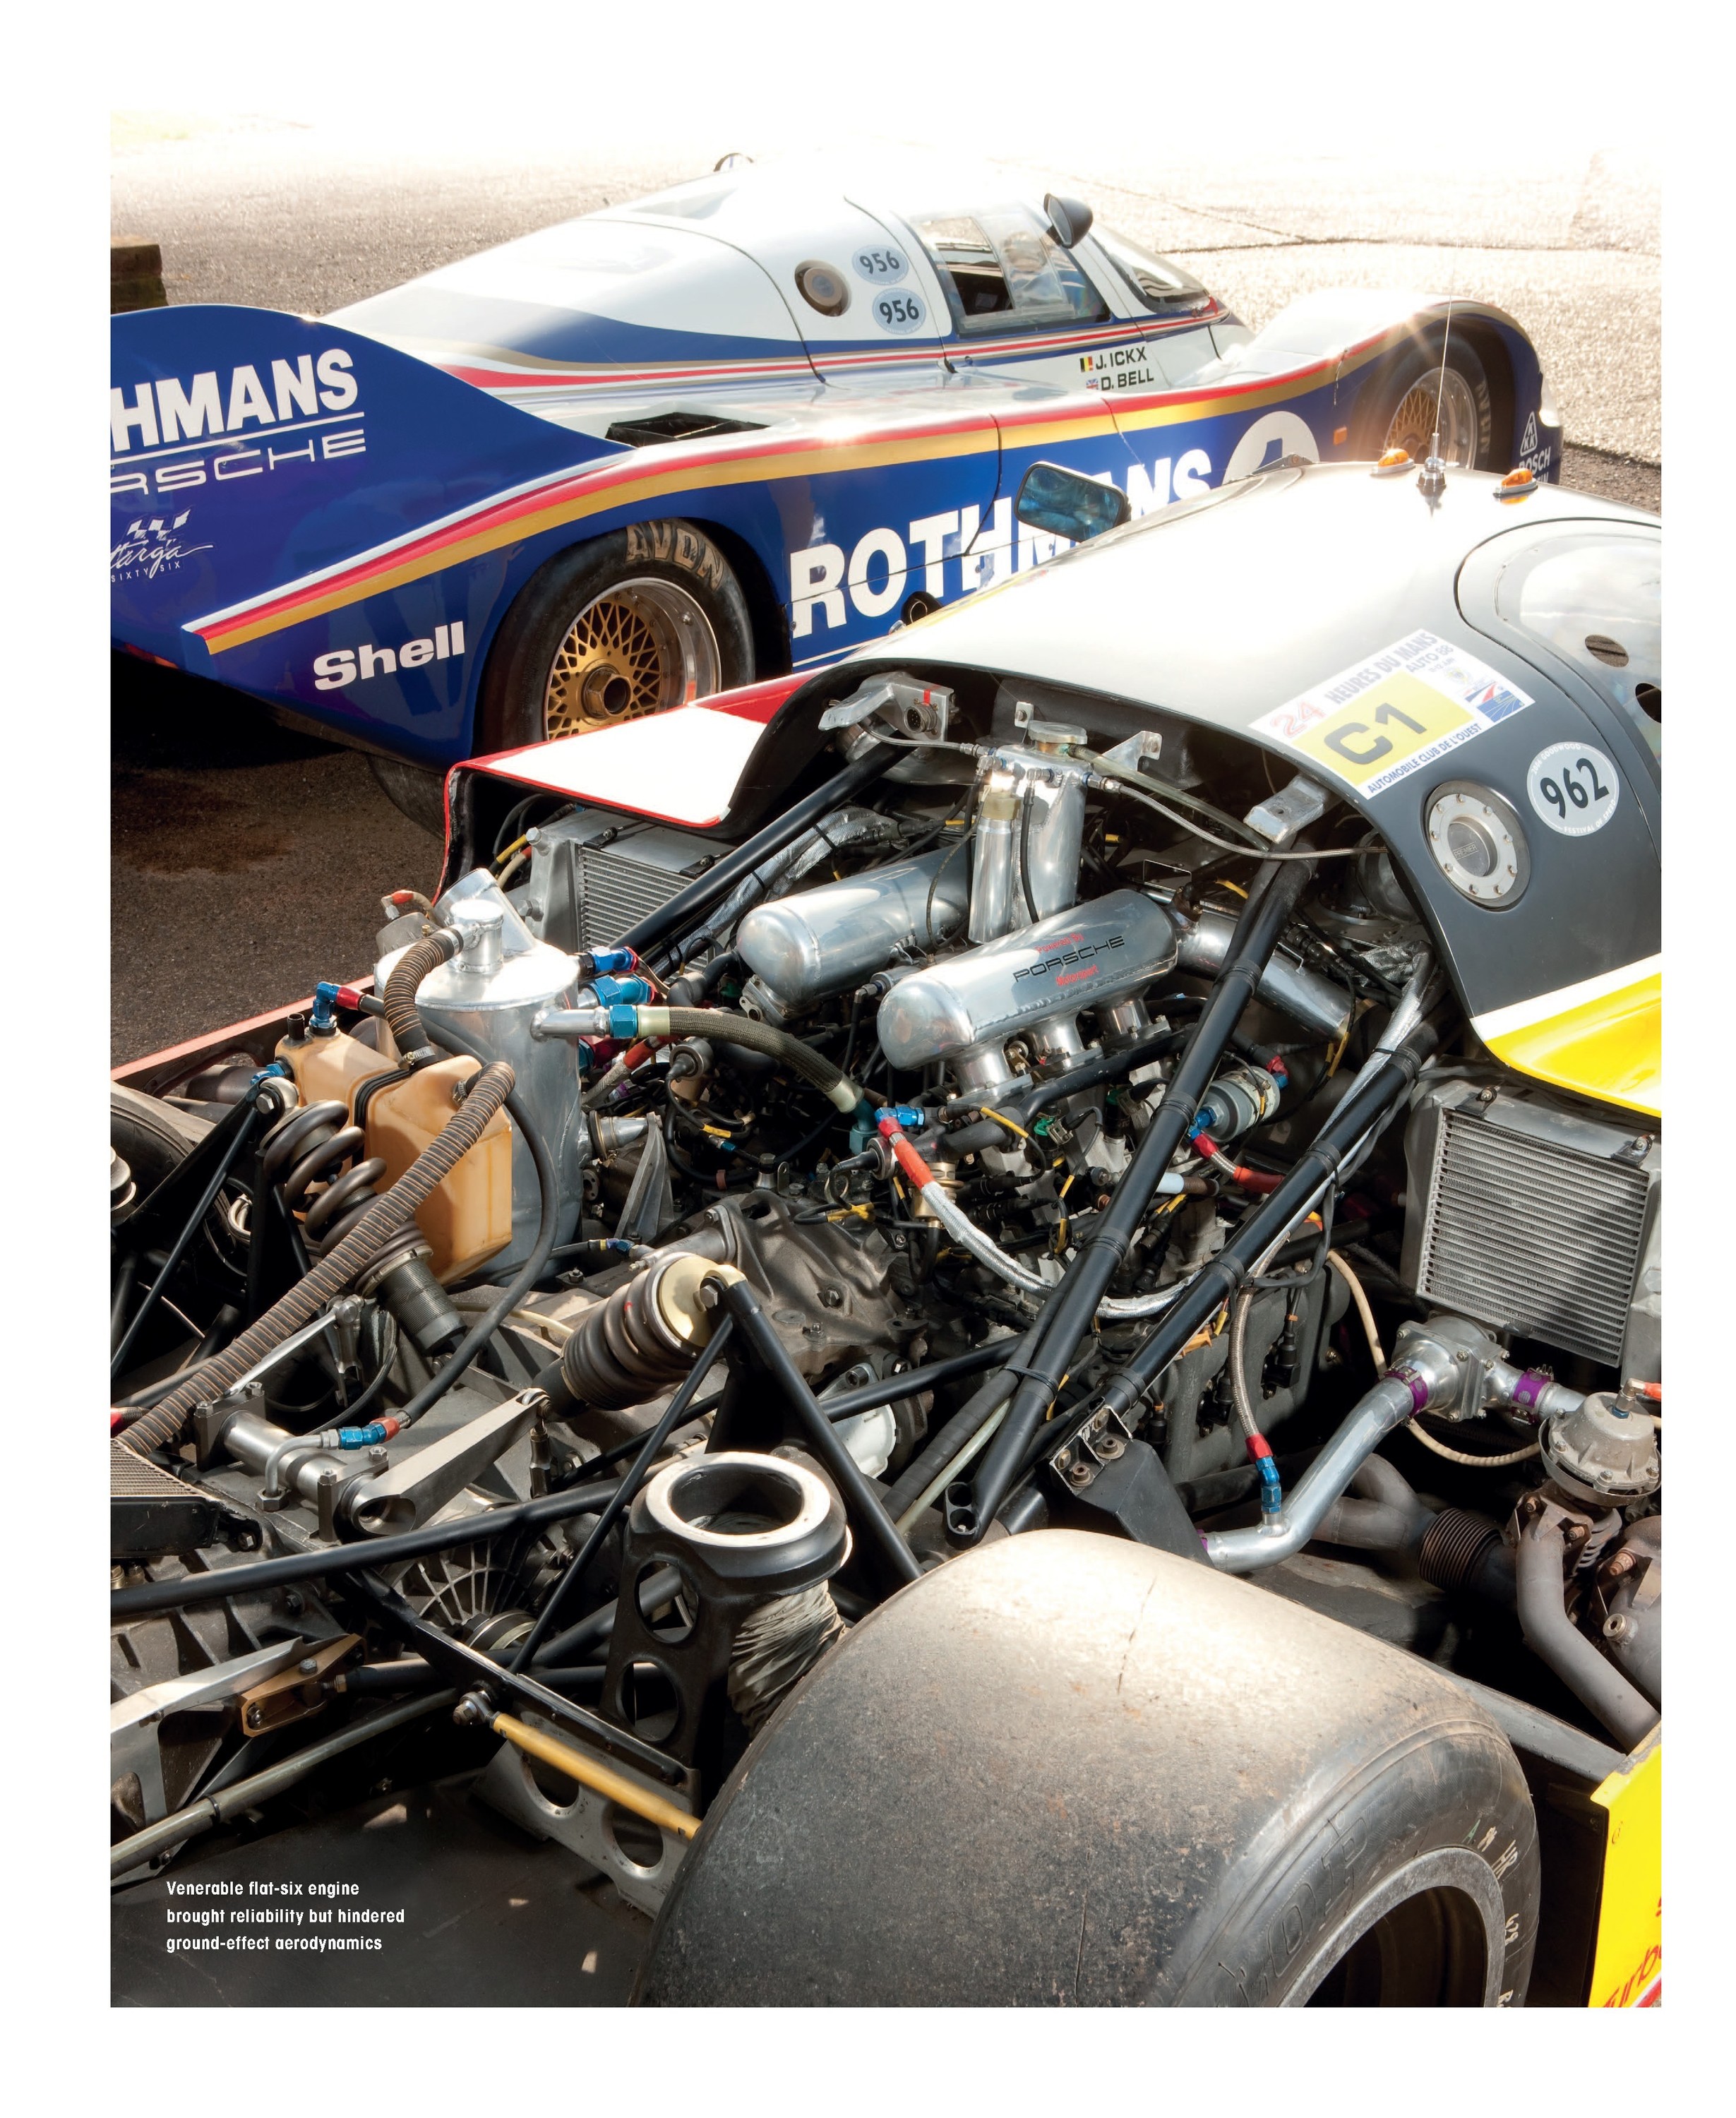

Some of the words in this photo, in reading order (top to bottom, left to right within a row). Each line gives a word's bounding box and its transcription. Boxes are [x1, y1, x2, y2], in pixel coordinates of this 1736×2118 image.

[860, 251, 900, 275] 956
[879, 297, 919, 325] 956
[1096, 354, 1107, 370] J.
[1110, 346, 1147, 367] ICKX
[1101, 376, 1114, 391] D.
[1118, 368, 1154, 388] BELL
[111, 567, 148, 582] SIXTY
[160, 561, 181, 573] SIX
[624, 520, 724, 593] AVON
[313, 621, 465, 690] Shell
[1406, 652, 1439, 672] AUTO
[1435, 645, 1454, 657] 88
[1271, 701, 1327, 738] 24
[1324, 670, 1382, 705] HEURES
[1377, 654, 1401, 673] DU
[1394, 633, 1438, 661] MANS
[1324, 702, 1427, 765] C1
[1540, 743, 1582, 760] GOODWOOD
[1367, 758, 1421, 794] AUTOMOBILE
[1418, 746, 1443, 764] CLUB
[1439, 739, 1452, 752] DE
[1449, 722, 1483, 746] L'OUEST
[1540, 758, 1610, 820] 962
[1564, 825, 1596, 834] FESTIVAL
[1595, 818, 1605, 828] OF
[1603, 798, 1617, 820] SPEED
[1012, 935, 1125, 983] PORSCHE
